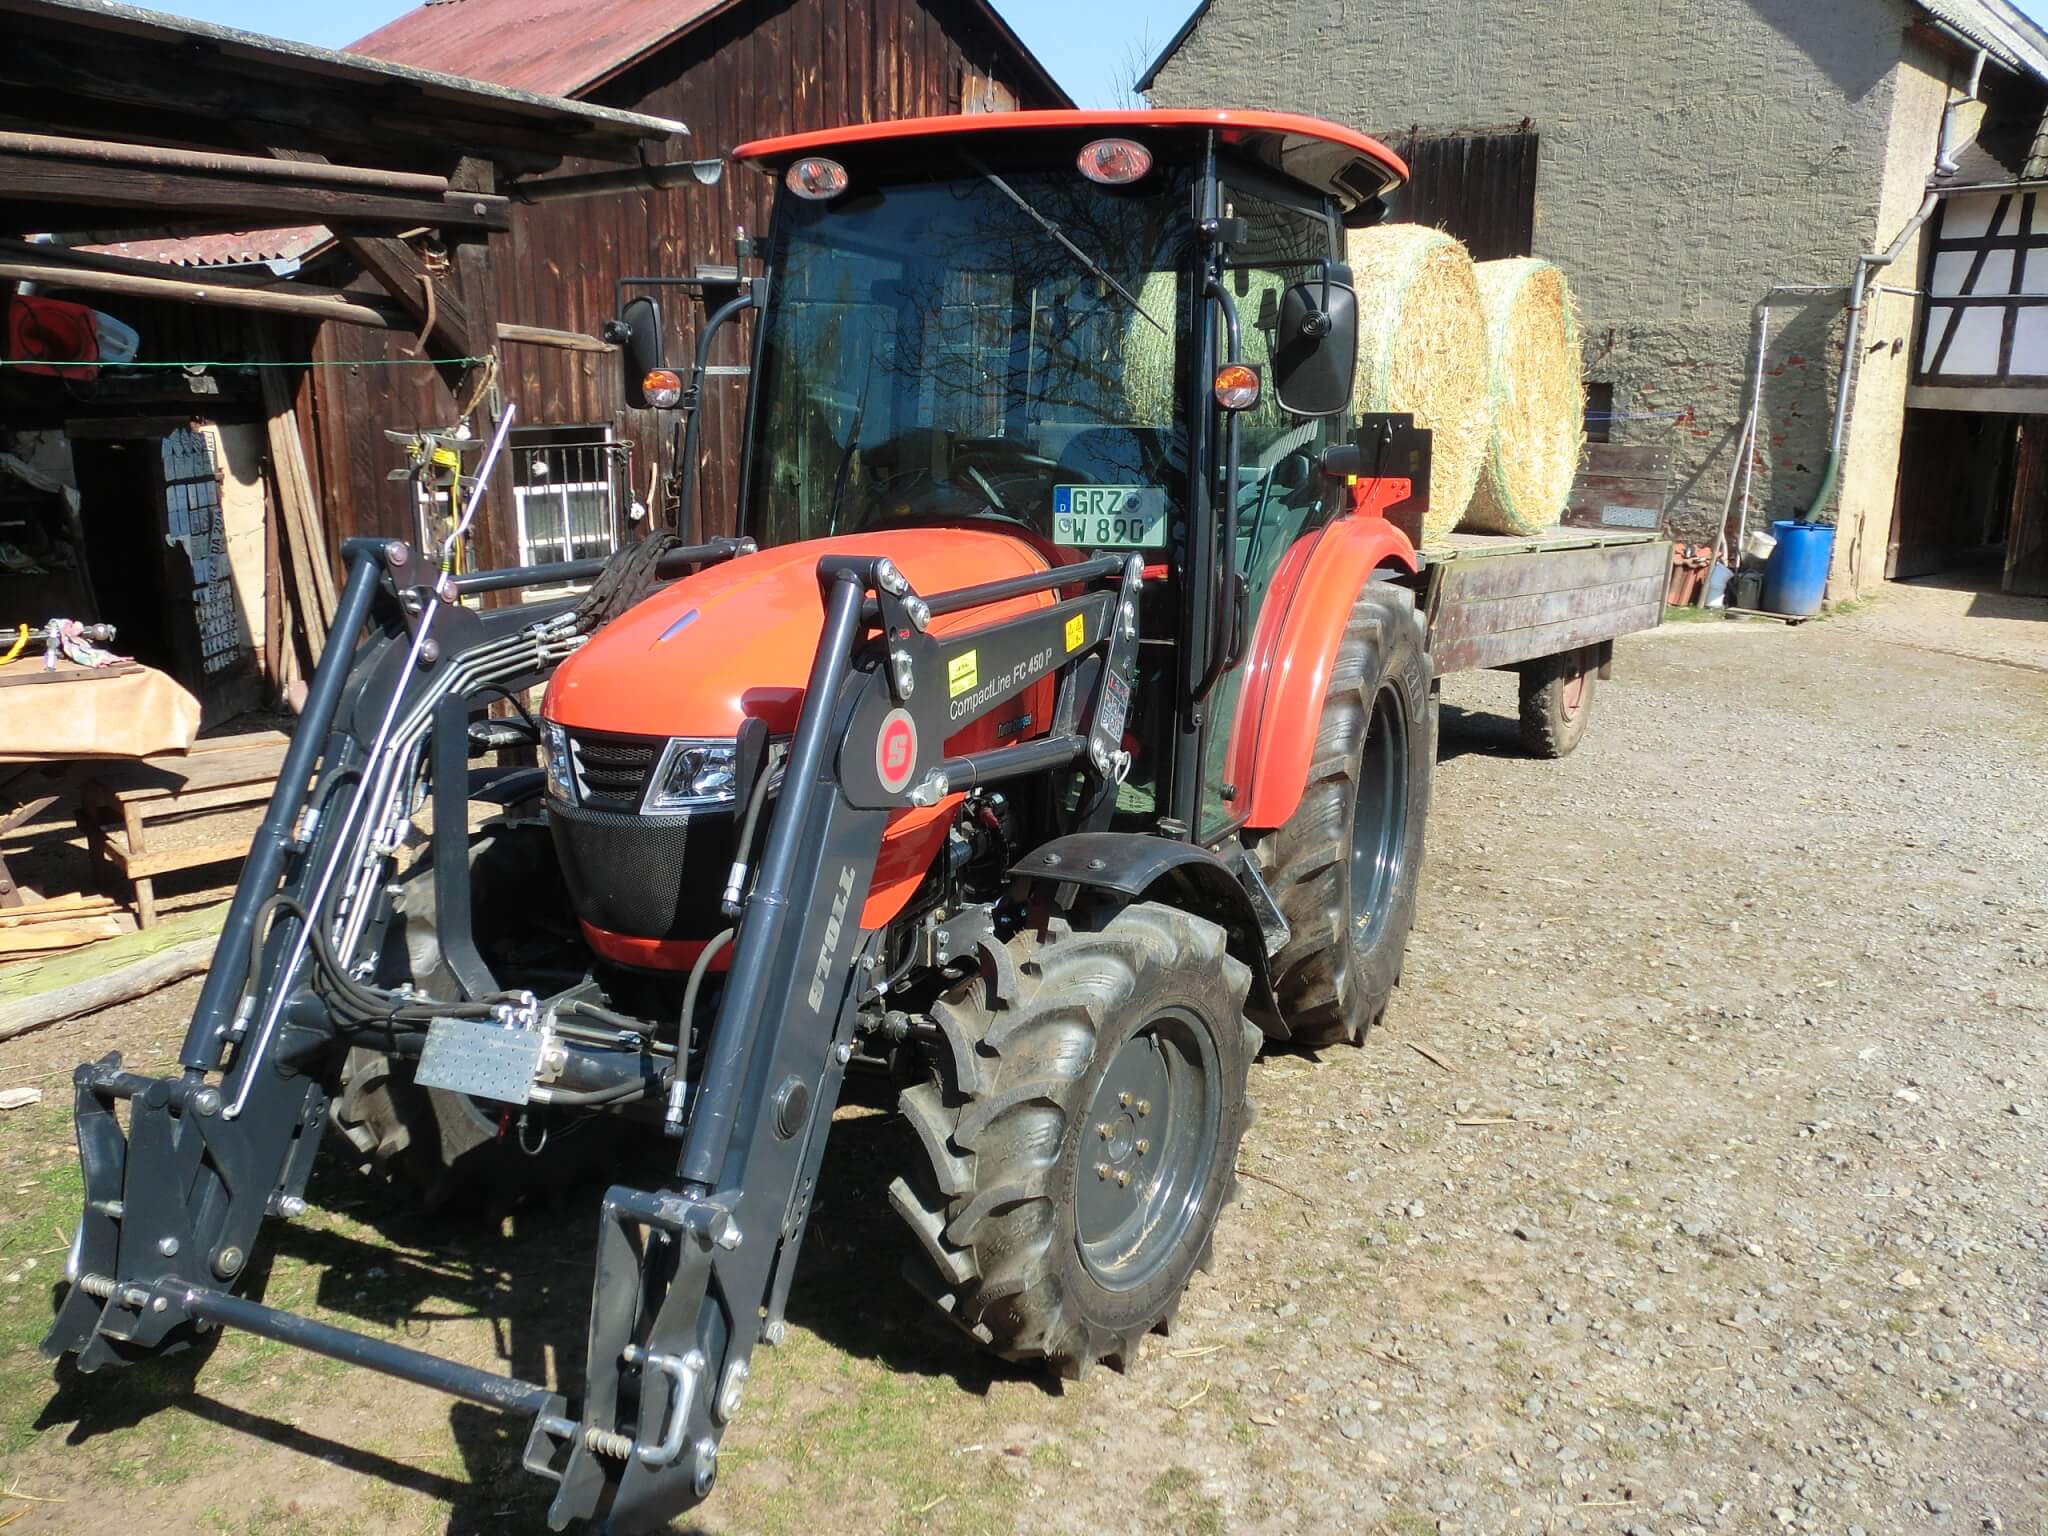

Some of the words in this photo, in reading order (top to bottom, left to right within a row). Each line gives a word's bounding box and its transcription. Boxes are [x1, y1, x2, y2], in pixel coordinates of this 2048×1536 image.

[1060, 503, 1066, 512] D
[1073, 490, 1122, 515] GRZ
[1072, 518, 1087, 543] W
[1096, 518, 1144, 543] 890
[950, 673, 1011, 721] CompactLine
[1013, 661, 1026, 685] FC
[1028, 651, 1044, 675] 450
[1045, 647, 1052, 667] P
[887, 733, 907, 768] S
[808, 864, 856, 1014] STOLL
